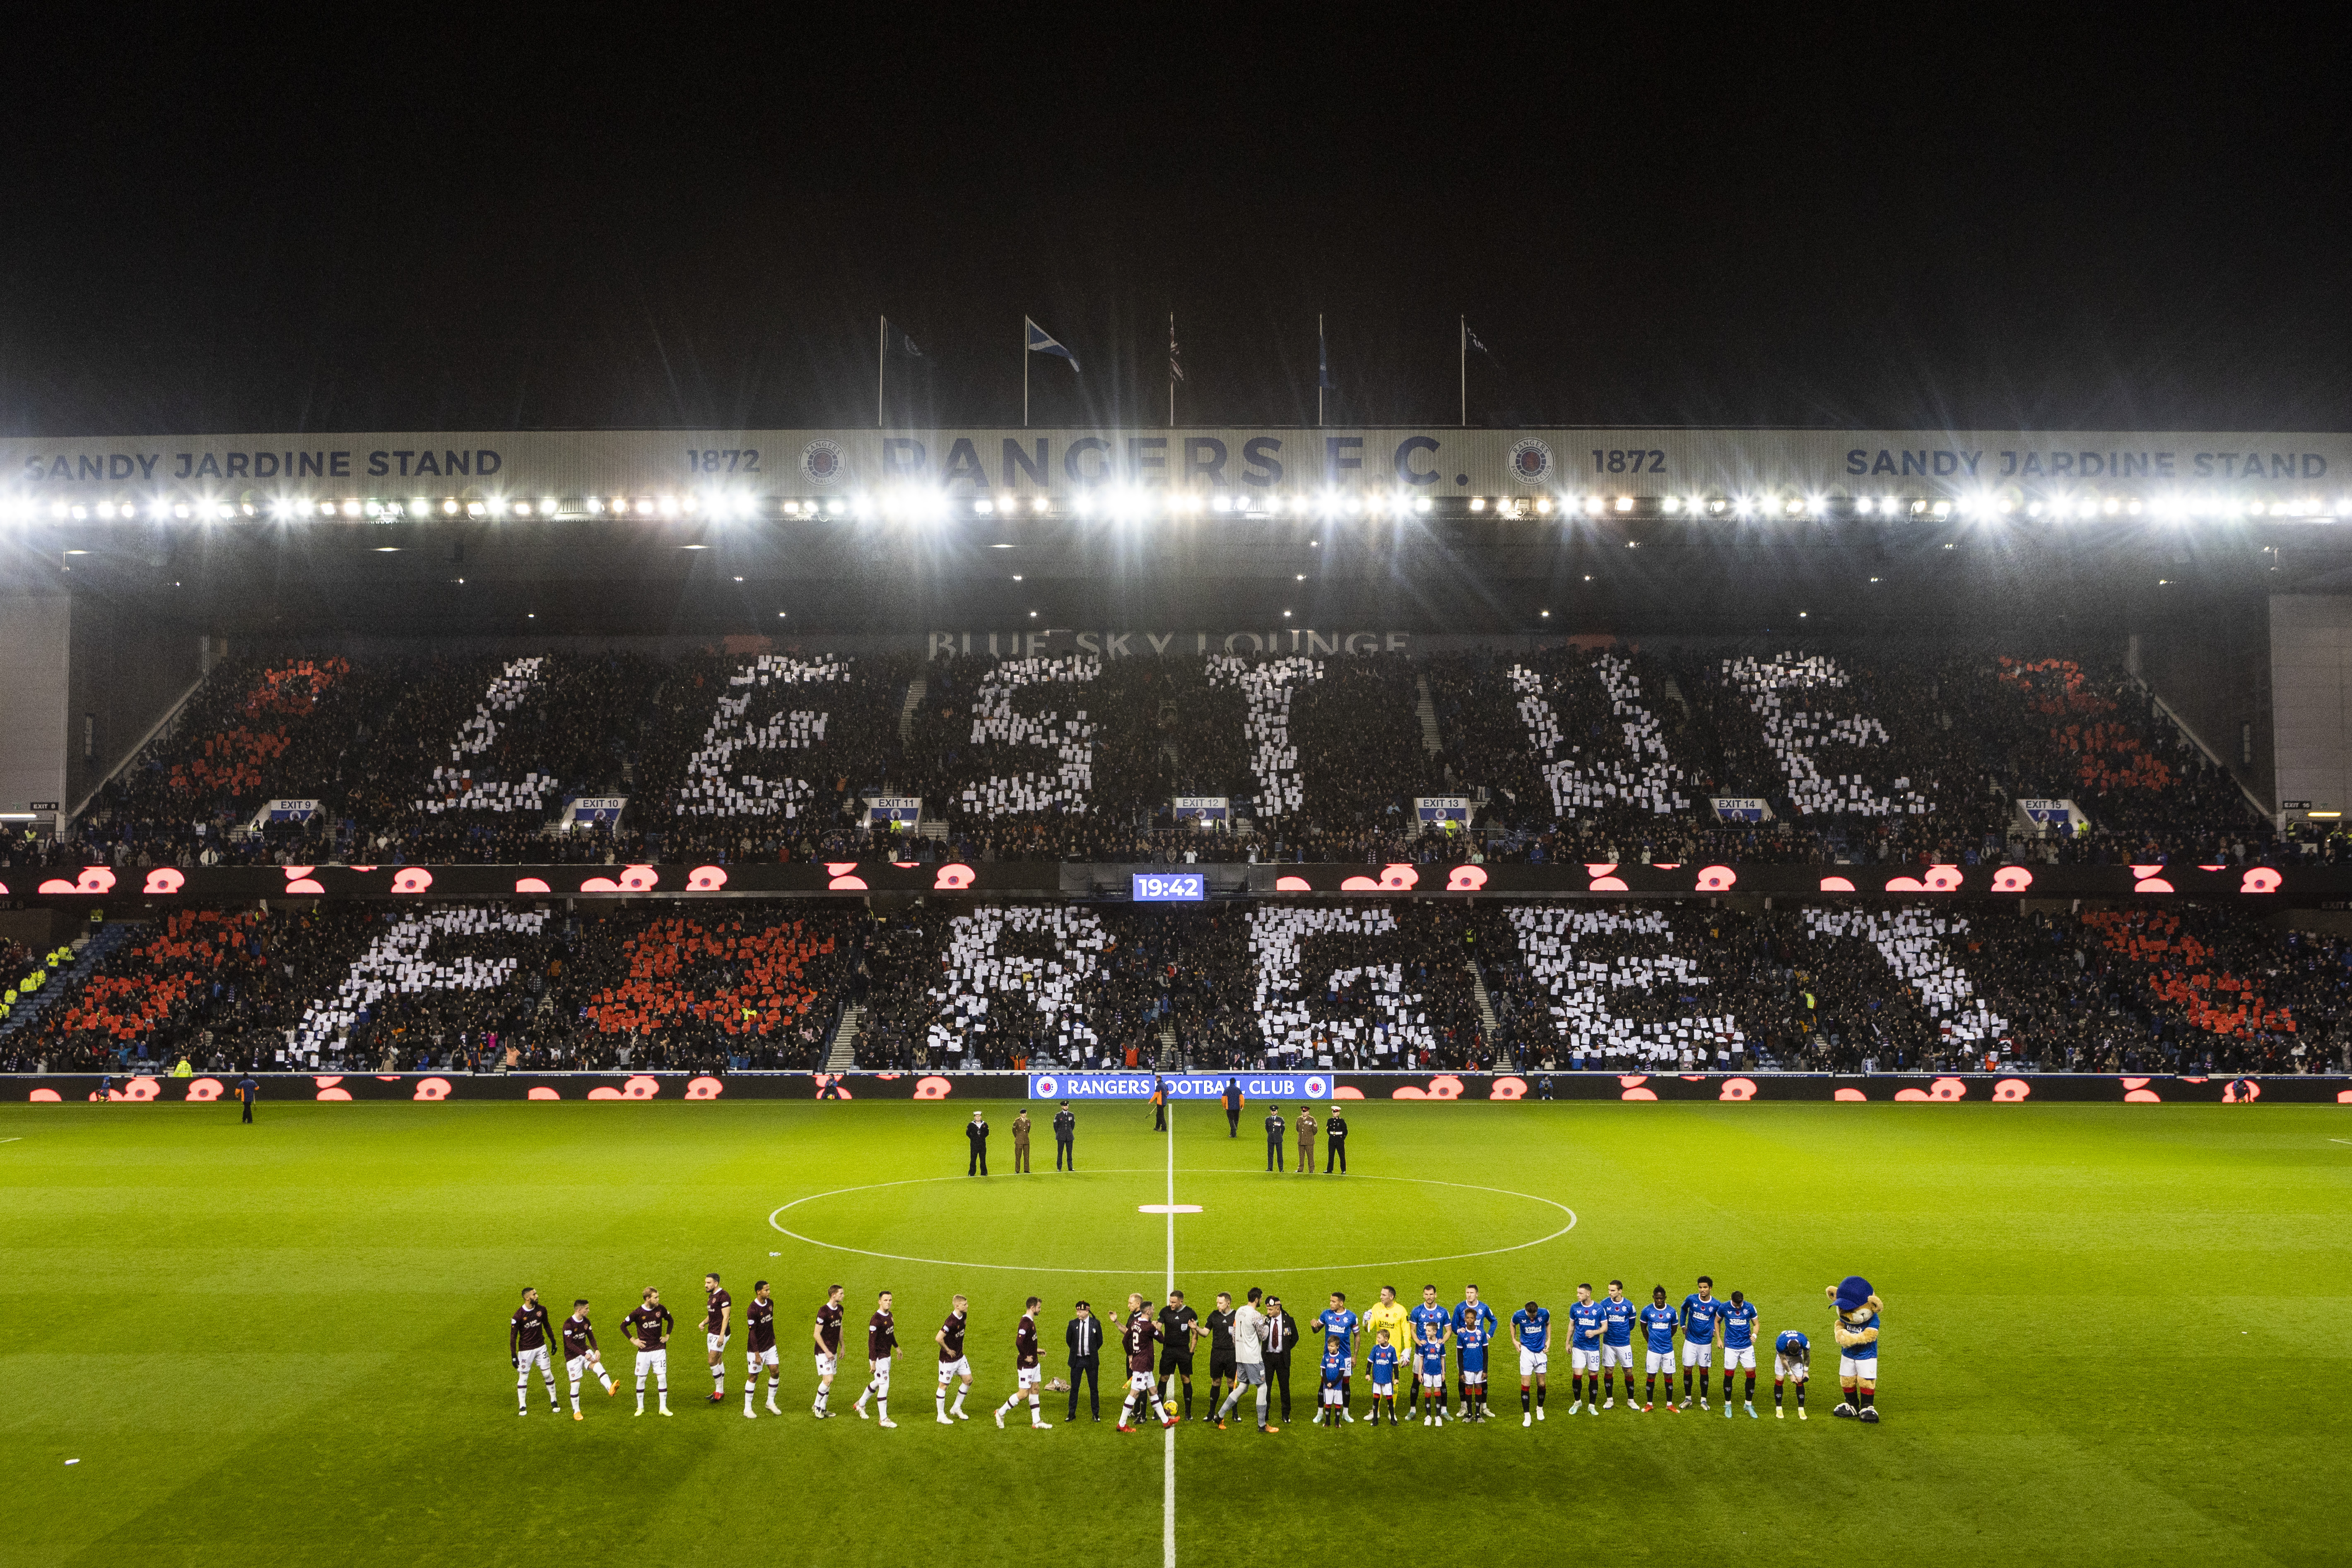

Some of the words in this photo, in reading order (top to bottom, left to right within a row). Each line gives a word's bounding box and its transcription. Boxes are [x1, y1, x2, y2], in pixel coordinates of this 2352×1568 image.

[805, 442, 841, 455] RANGERS
[1513, 440, 1549, 453] RANGERS
[24, 453, 160, 481] SANDY
[174, 450, 350, 479] JARDINE
[368, 449, 502, 477] STAND
[687, 449, 760, 472] 1872
[883, 437, 1283, 487] RANGERS
[1592, 450, 1667, 474] 1872
[1846, 449, 1983, 476] SANDY
[2000, 450, 2176, 478] JARDINE
[2194, 453, 2328, 479] STAND
[803, 467, 830, 484] FOOTBALL
[831, 466, 843, 480] CLUB
[1511, 465, 1539, 482] FOOTBALL
[1540, 465, 1552, 479] CLUB
[1077, 631, 1174, 661] SKY
[1198, 629, 1410, 660] LOUNGE
[2050, 800, 2061, 809] 15
[1139, 878, 1198, 896] 19:42
[1068, 1080, 1149, 1094] RANGERS
[1249, 1080, 1295, 1094] CLUB
[1240, 1321, 1242, 1337] 1
[1133, 1332, 1140, 1350] 2
